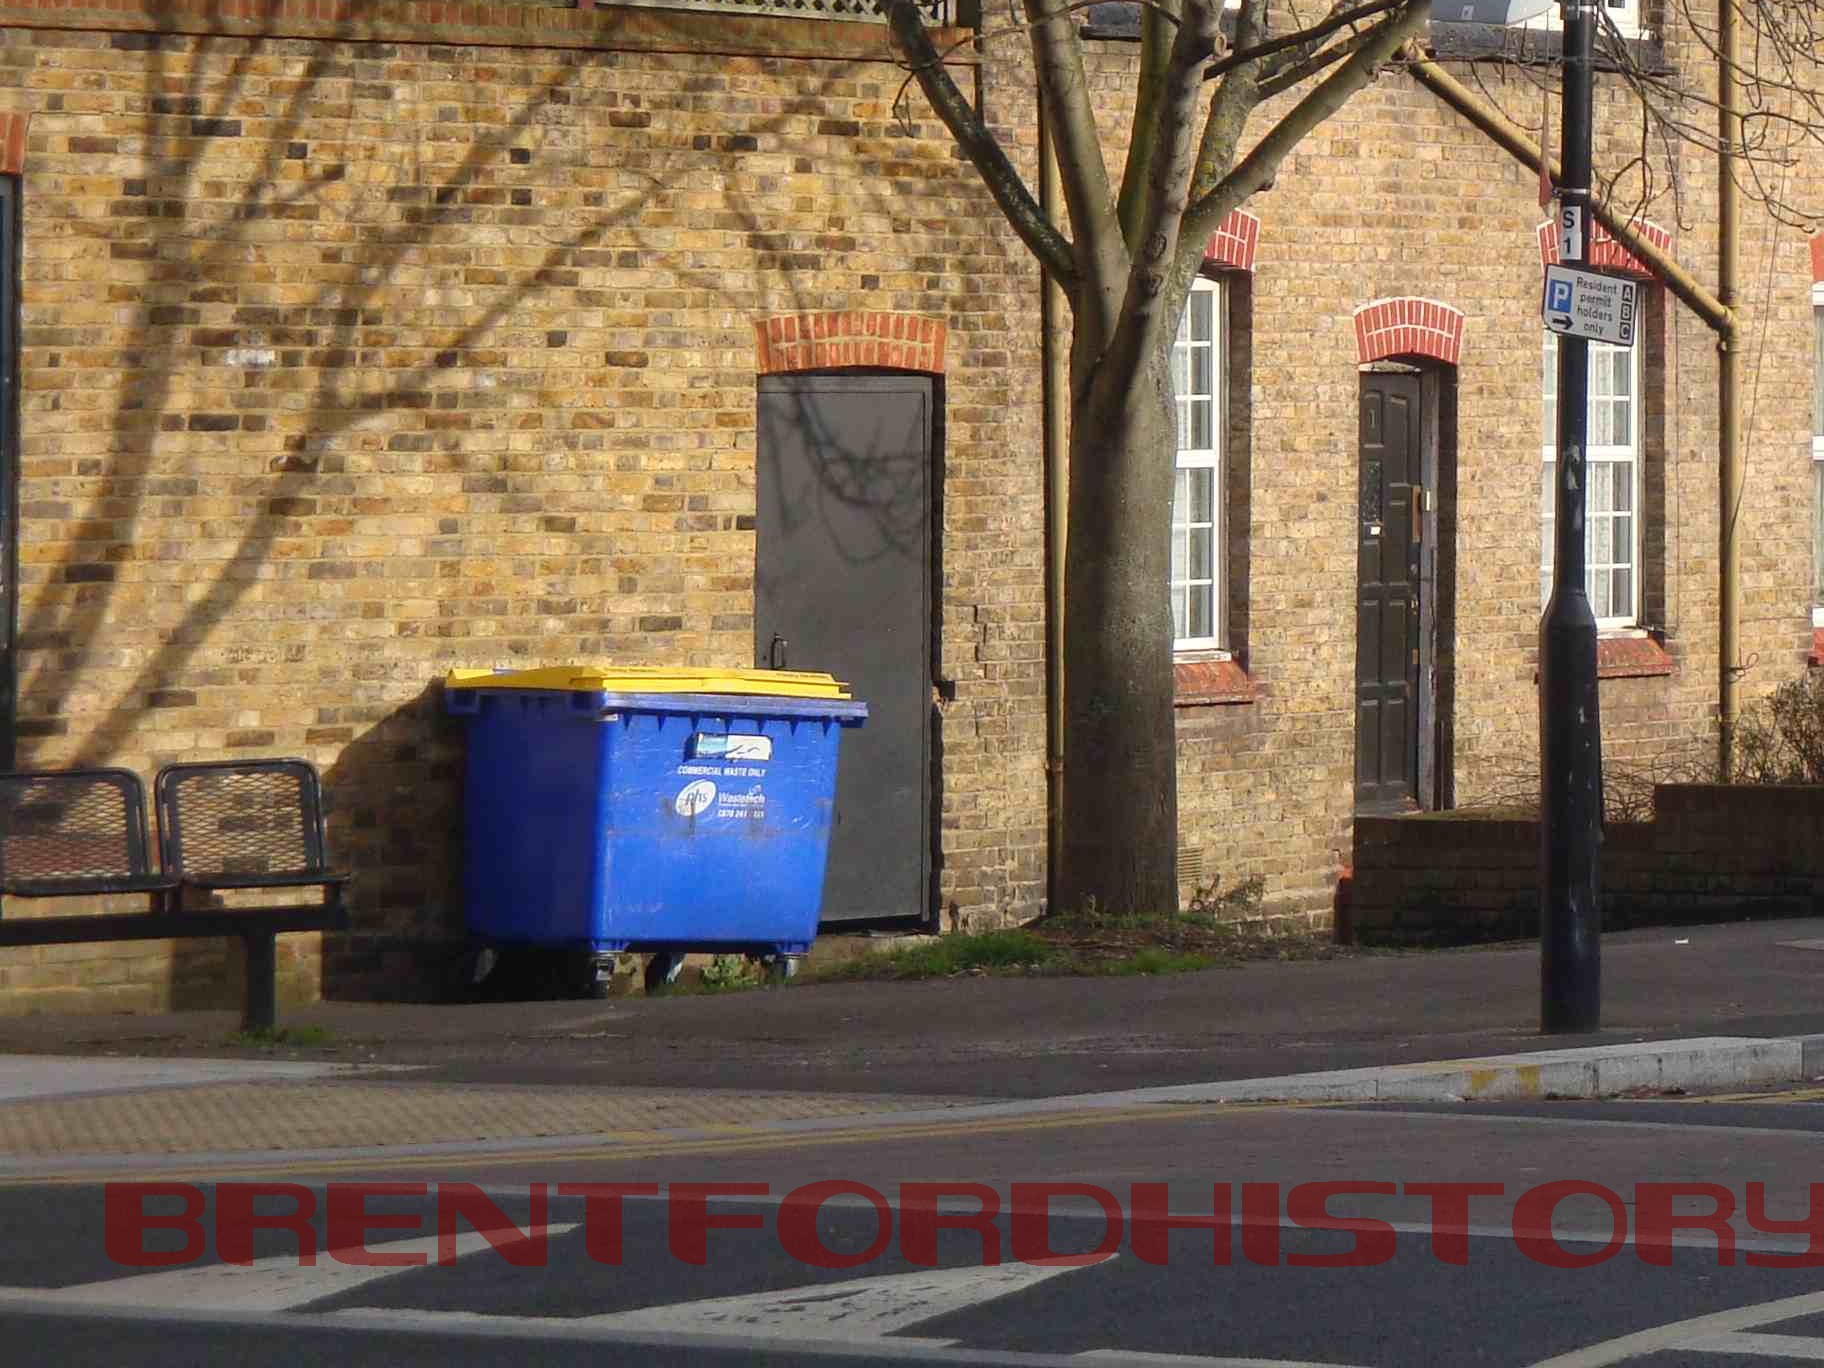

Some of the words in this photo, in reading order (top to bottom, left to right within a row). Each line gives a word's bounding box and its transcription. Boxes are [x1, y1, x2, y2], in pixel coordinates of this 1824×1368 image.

[1563, 210, 1575, 229] S
[1563, 238, 1571, 254] 1
[1576, 277, 1617, 295] Resident
[1623, 286, 1633, 302] A
[1554, 283, 1569, 309] P
[1580, 293, 1612, 308] permit
[1577, 307, 1613, 322] holders
[1622, 304, 1632, 321] B
[1584, 321, 1604, 335] only
[1620, 323, 1630, 339] C
[677, 765, 722, 776] COMMERCIAL
[724, 767, 748, 777] WASTE
[749, 768, 766, 777] ONLY
[686, 789, 708, 805] phs
